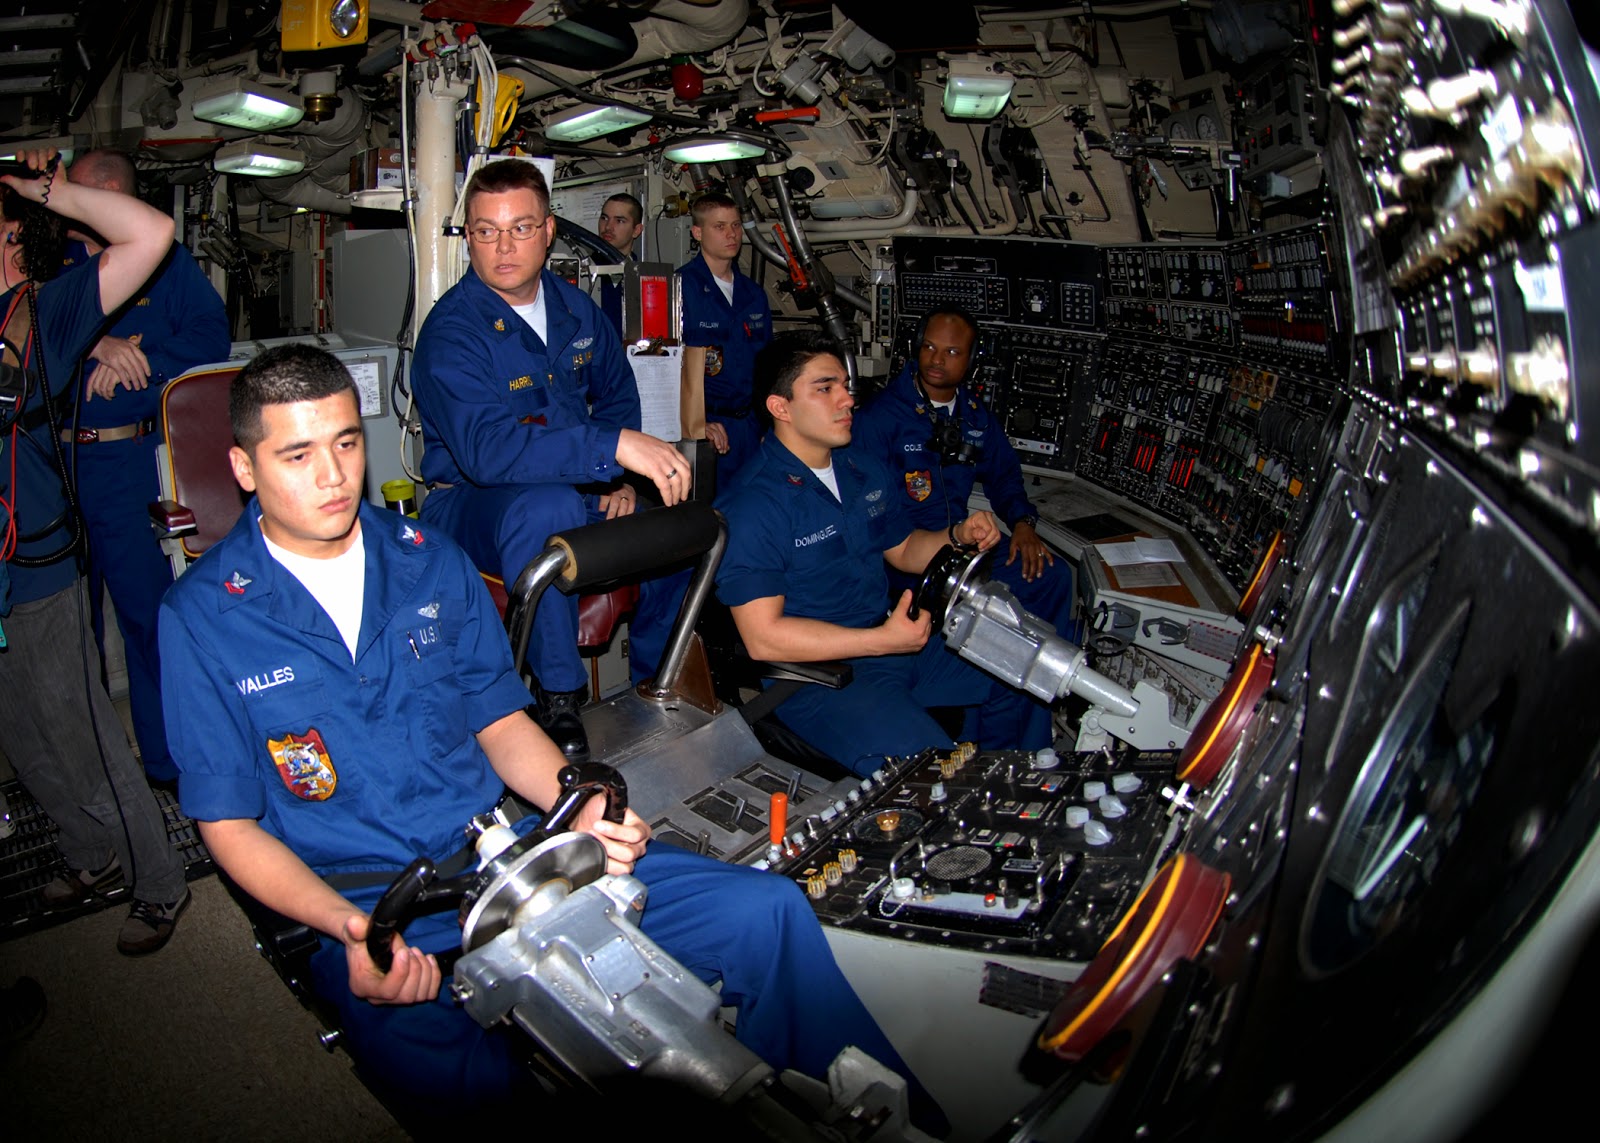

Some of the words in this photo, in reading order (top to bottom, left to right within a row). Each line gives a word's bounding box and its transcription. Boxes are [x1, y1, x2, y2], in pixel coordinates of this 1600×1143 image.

[509, 375, 534, 392] HARRIS
[904, 443, 923, 452] COLE
[419, 625, 438, 645] U.S.
[236, 666, 295, 696] VALLES
